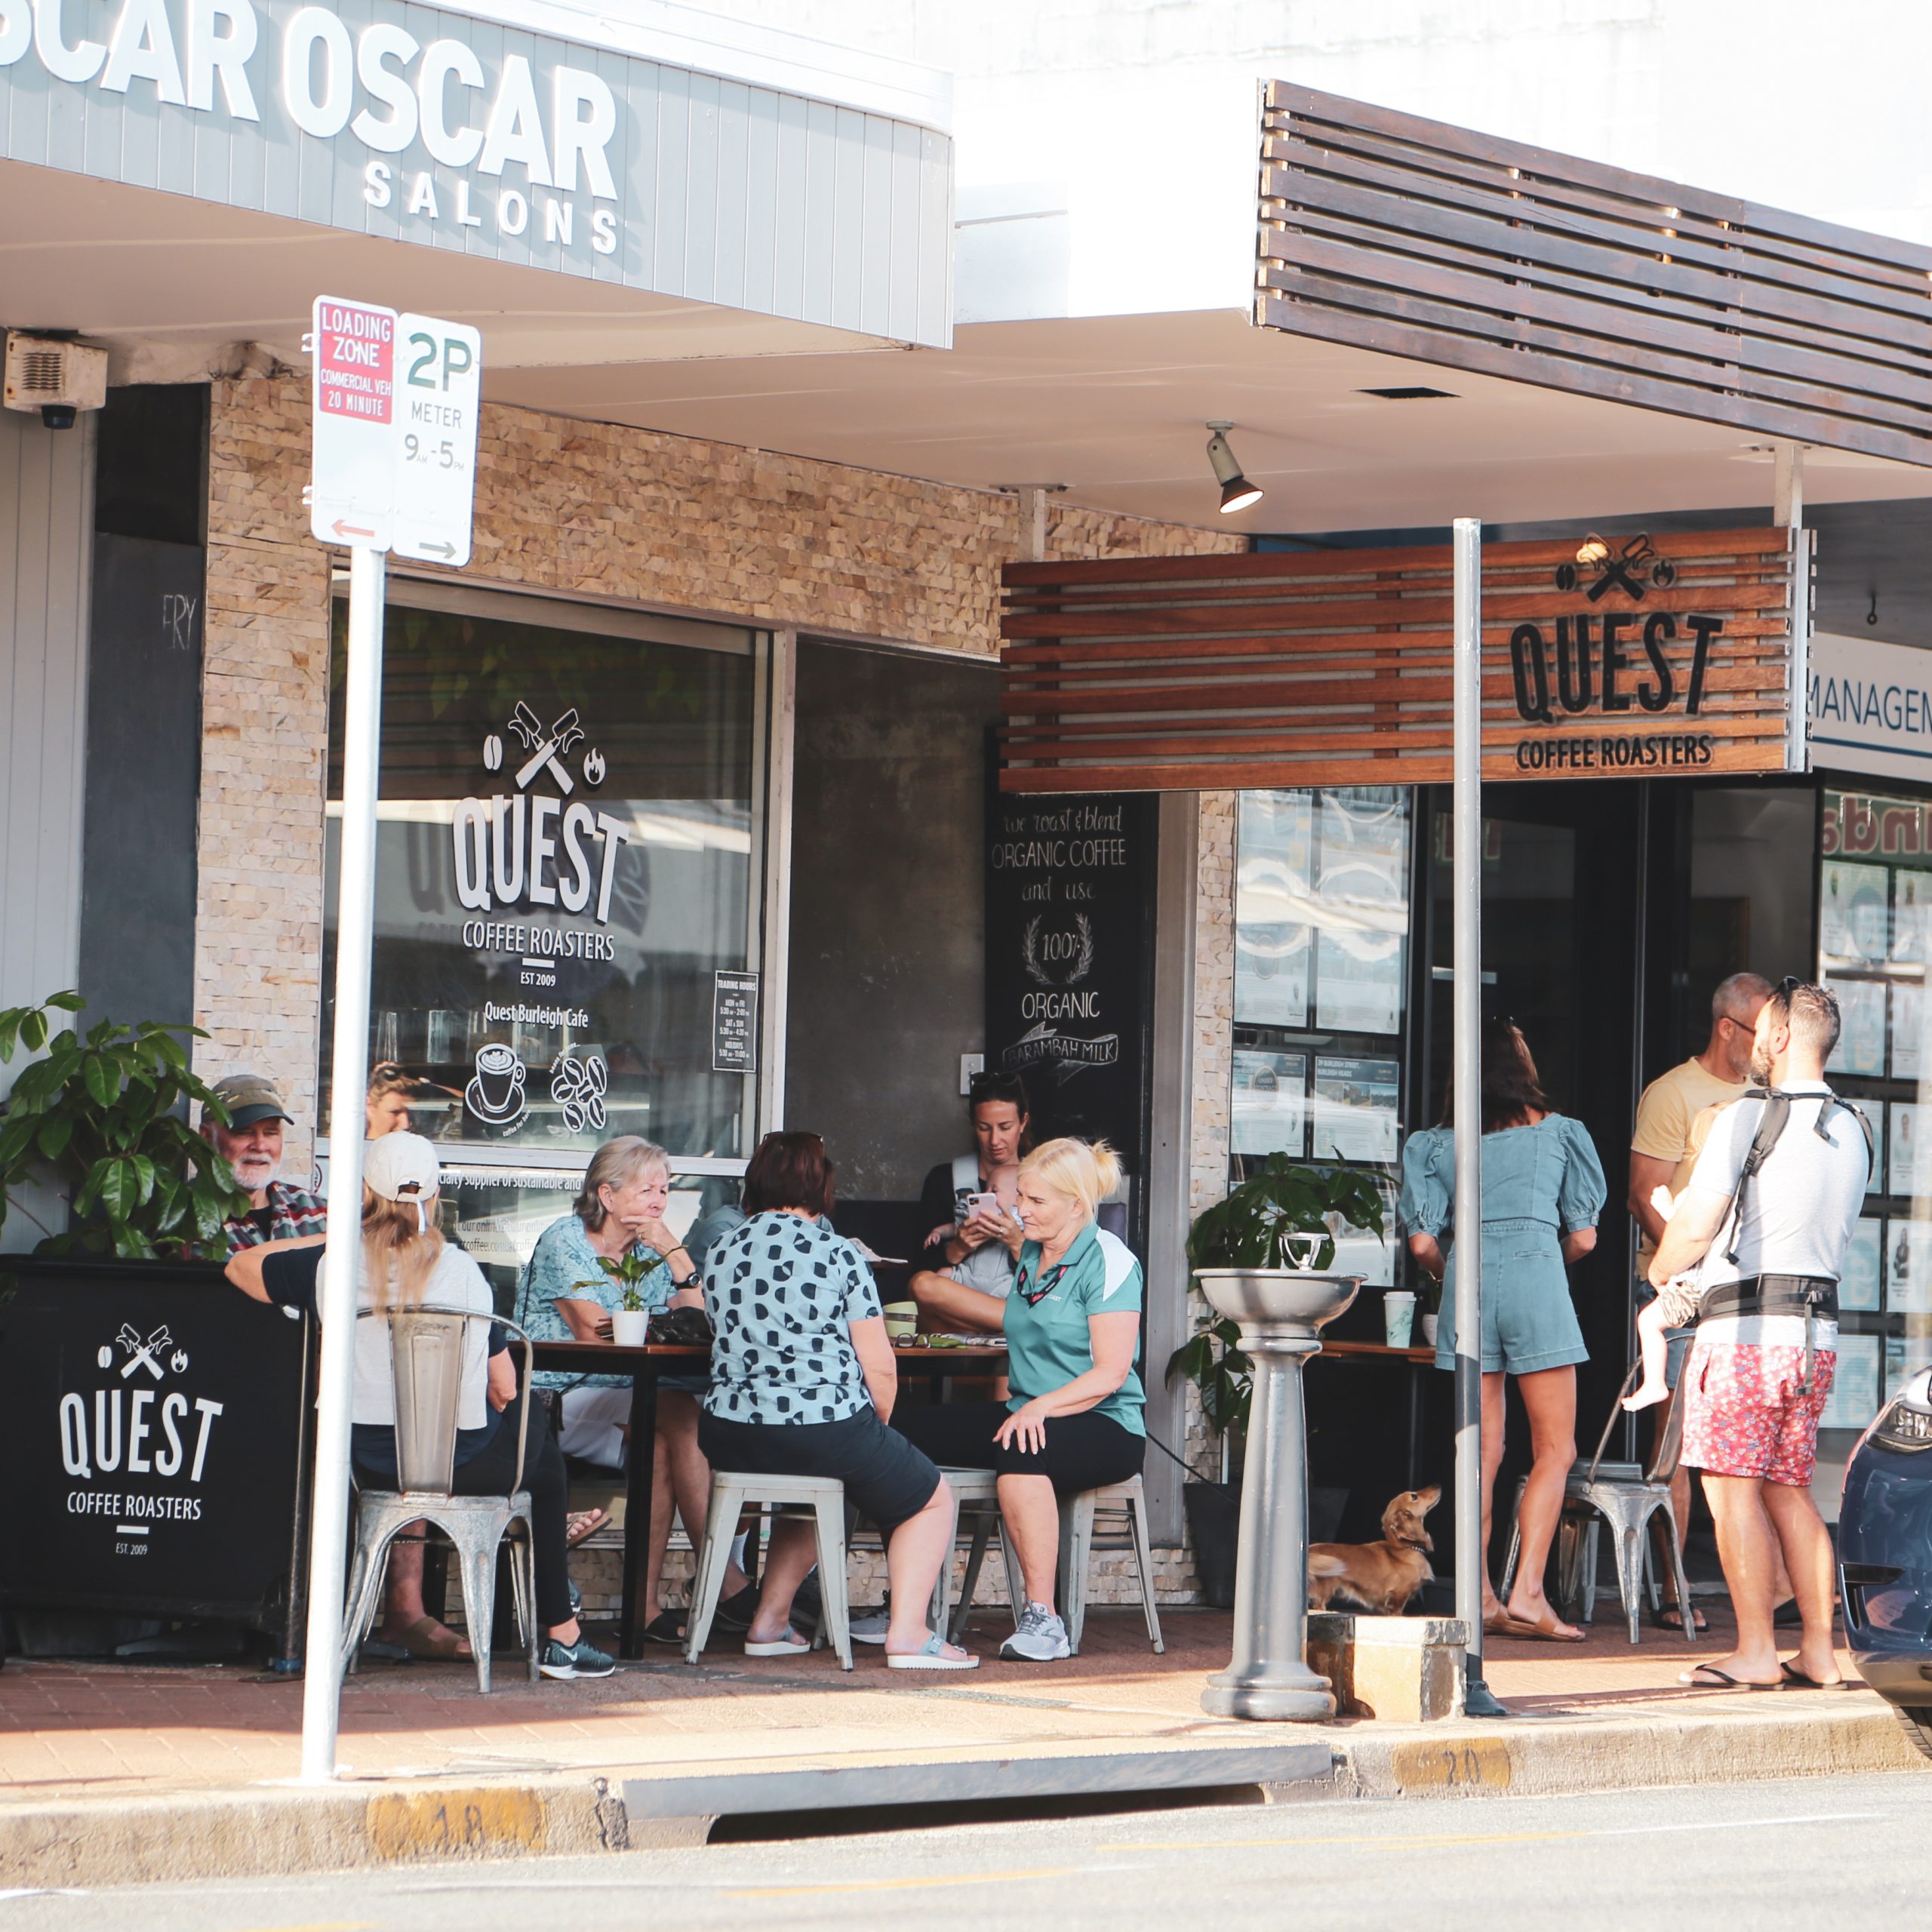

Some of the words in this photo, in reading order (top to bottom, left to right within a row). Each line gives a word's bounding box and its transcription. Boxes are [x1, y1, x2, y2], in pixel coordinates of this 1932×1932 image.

[0, 0, 260, 122] CAR
[283, 6, 618, 200] OSCAR
[364, 161, 617, 254] SALONS
[322, 306, 391, 343] LOADING
[333, 336, 380, 368] ZONE
[408, 332, 472, 392] 2P
[321, 368, 373, 392] COMMERCIAL
[374, 380, 391, 396] VEH
[328, 390, 341, 408] 20
[346, 395, 383, 417] MINUTE
[411, 401, 462, 429] METER
[1510, 612, 1724, 724] QUEST
[1516, 739, 1594, 770] COFFEE
[1601, 735, 1711, 766] ROASTERS
[1033, 808, 1072, 832] roast
[1084, 805, 1121, 832] blend
[454, 794, 629, 923] QUEST
[992, 841, 1066, 869] ORGANIC
[1069, 838, 1126, 867] COFFEE
[1022, 875, 1051, 901] and
[1066, 884, 1097, 900] use
[463, 920, 525, 952] COFFEE
[530, 927, 615, 961] ROASTERS
[1042, 933, 1080, 961] 100%
[521, 971, 534, 985] EST
[536, 974, 555, 986] 2009
[718, 980, 739, 989] TRADING
[739, 981, 756, 991] HOURS
[485, 1001, 515, 1021] Quest
[518, 1004, 563, 1029] Burleigh
[566, 1008, 589, 1027] Cafe
[1022, 992, 1100, 1019] ORGANIC
[1008, 1038, 1078, 1064] BARAMBAH
[1082, 1042, 1114, 1061] MILK
[465, 1174, 500, 1190] supplier
[502, 1175, 512, 1187] of
[512, 1175, 562, 1189] sustainable
[565, 1177, 581, 1191] and
[60, 1389, 223, 1482] QUEST
[67, 1492, 121, 1515] COFFEE
[125, 1495, 202, 1521] ROASTERS
[115, 1543, 129, 1555] EST.
[131, 1543, 148, 1555] 2009
